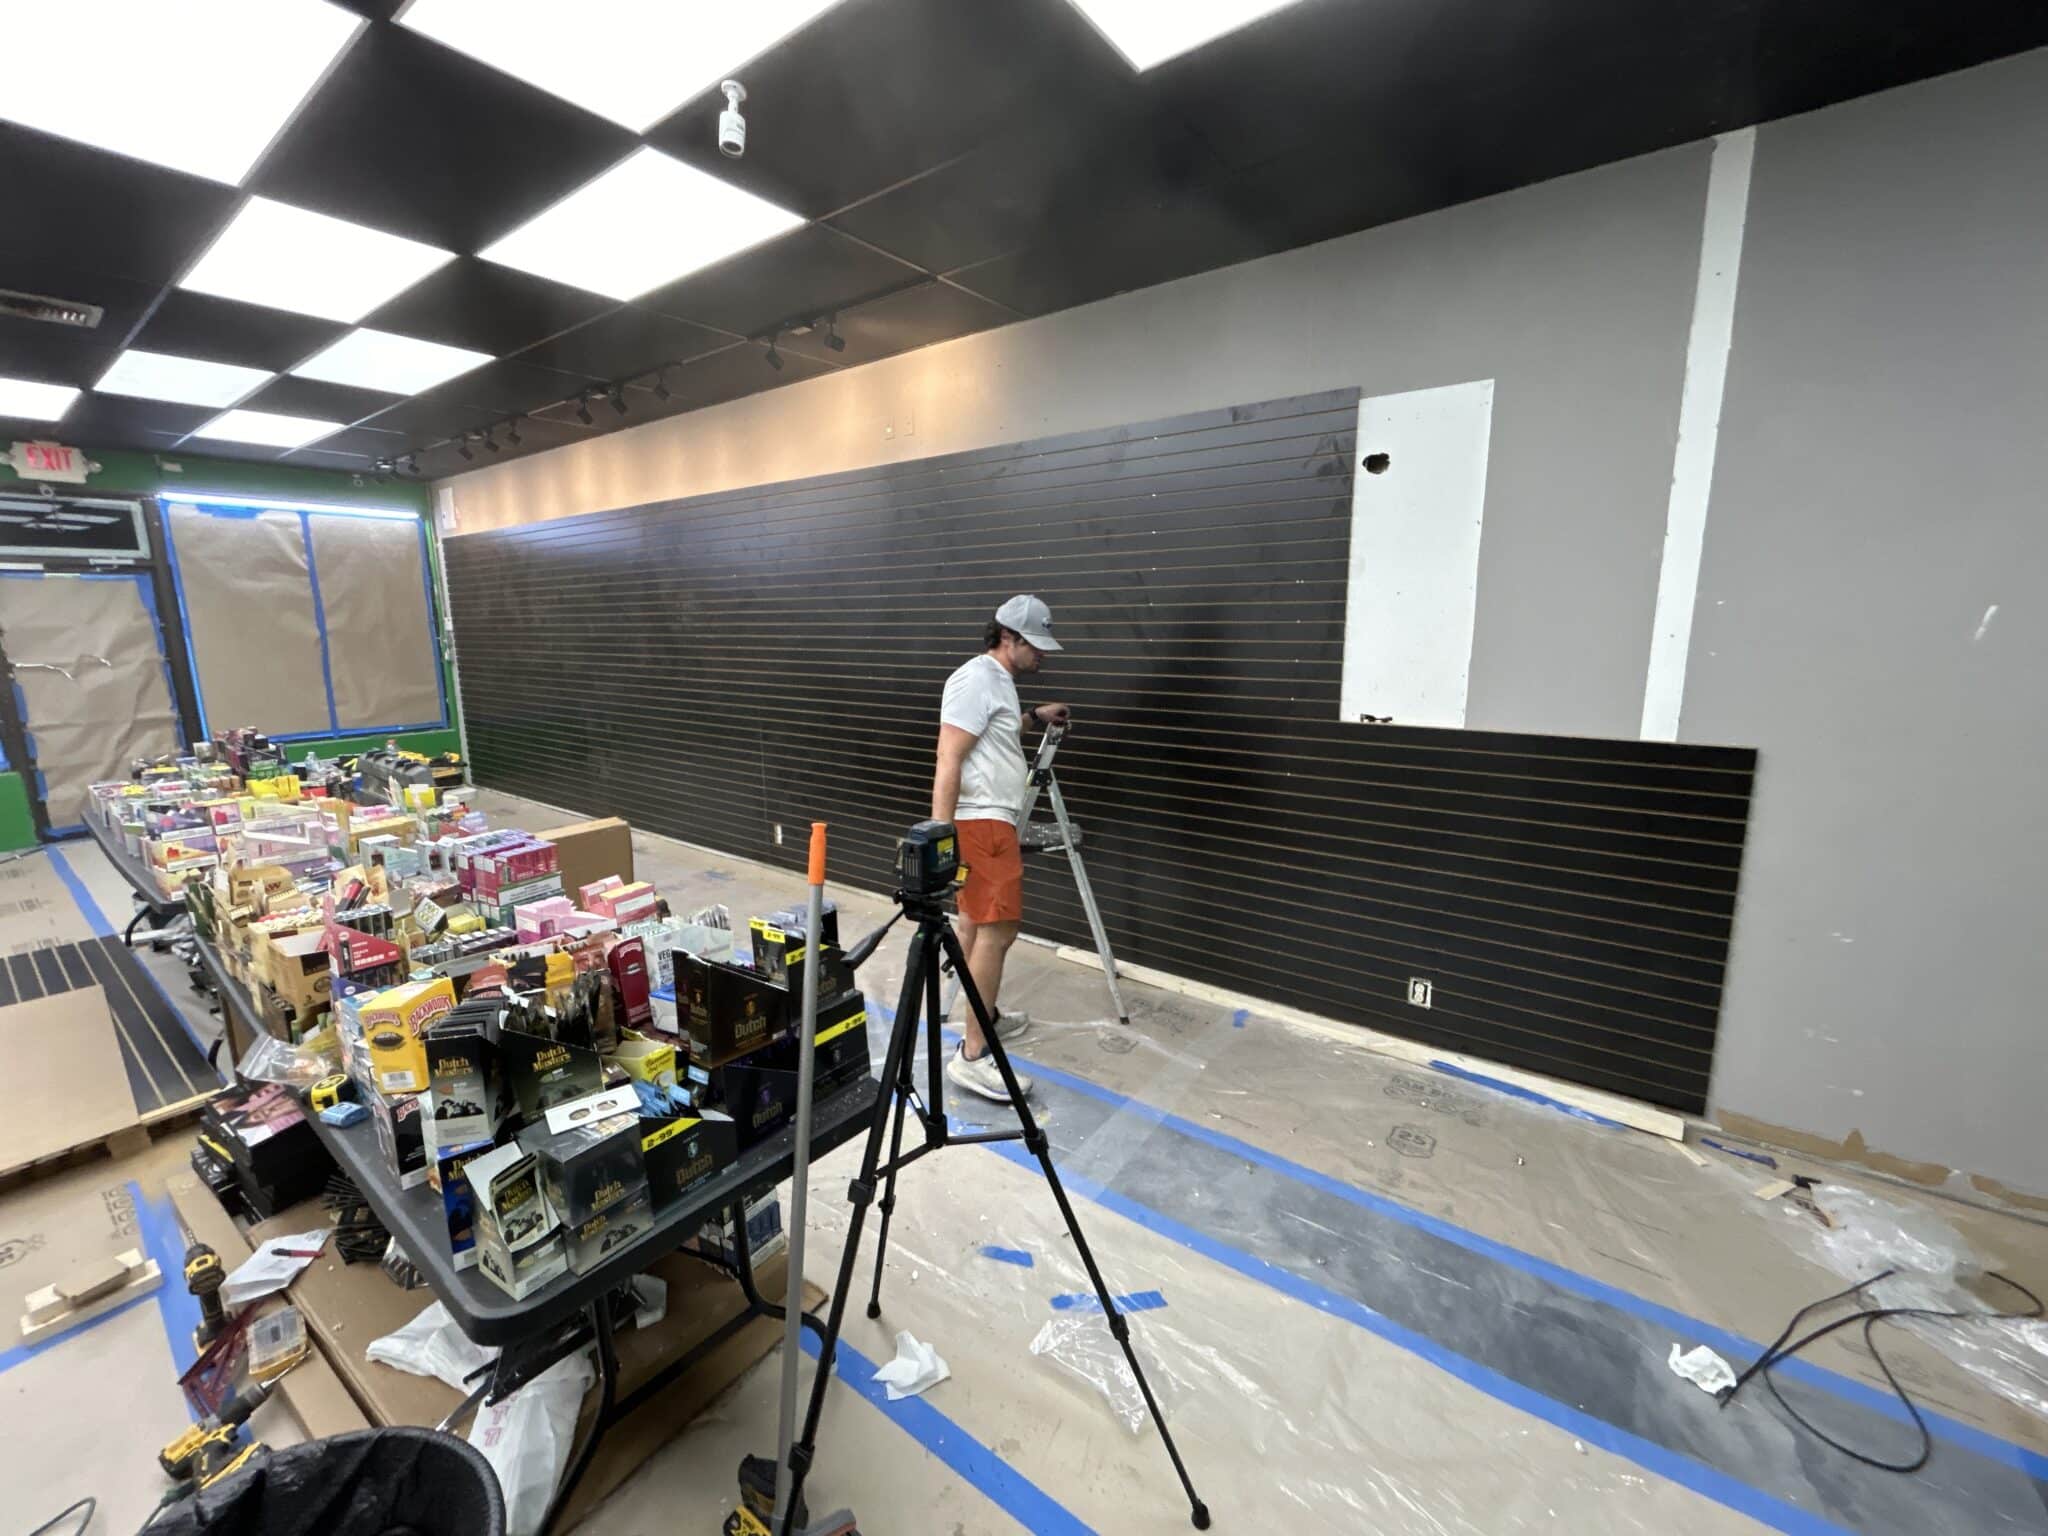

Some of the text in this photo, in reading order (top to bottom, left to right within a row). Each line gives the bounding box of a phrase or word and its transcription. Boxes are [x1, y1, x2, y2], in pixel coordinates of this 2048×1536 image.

[26, 444, 73, 471] EXIT
[409, 995, 453, 1036] BACKWOODS
[438, 1057, 470, 1069] Dutch
[532, 1053, 571, 1072] Masters
[536, 1045, 566, 1062] Dutch
[676, 1154, 713, 1186] Dutch
[595, 1180, 622, 1203] Dutch
[584, 1215, 607, 1234] Dutch
